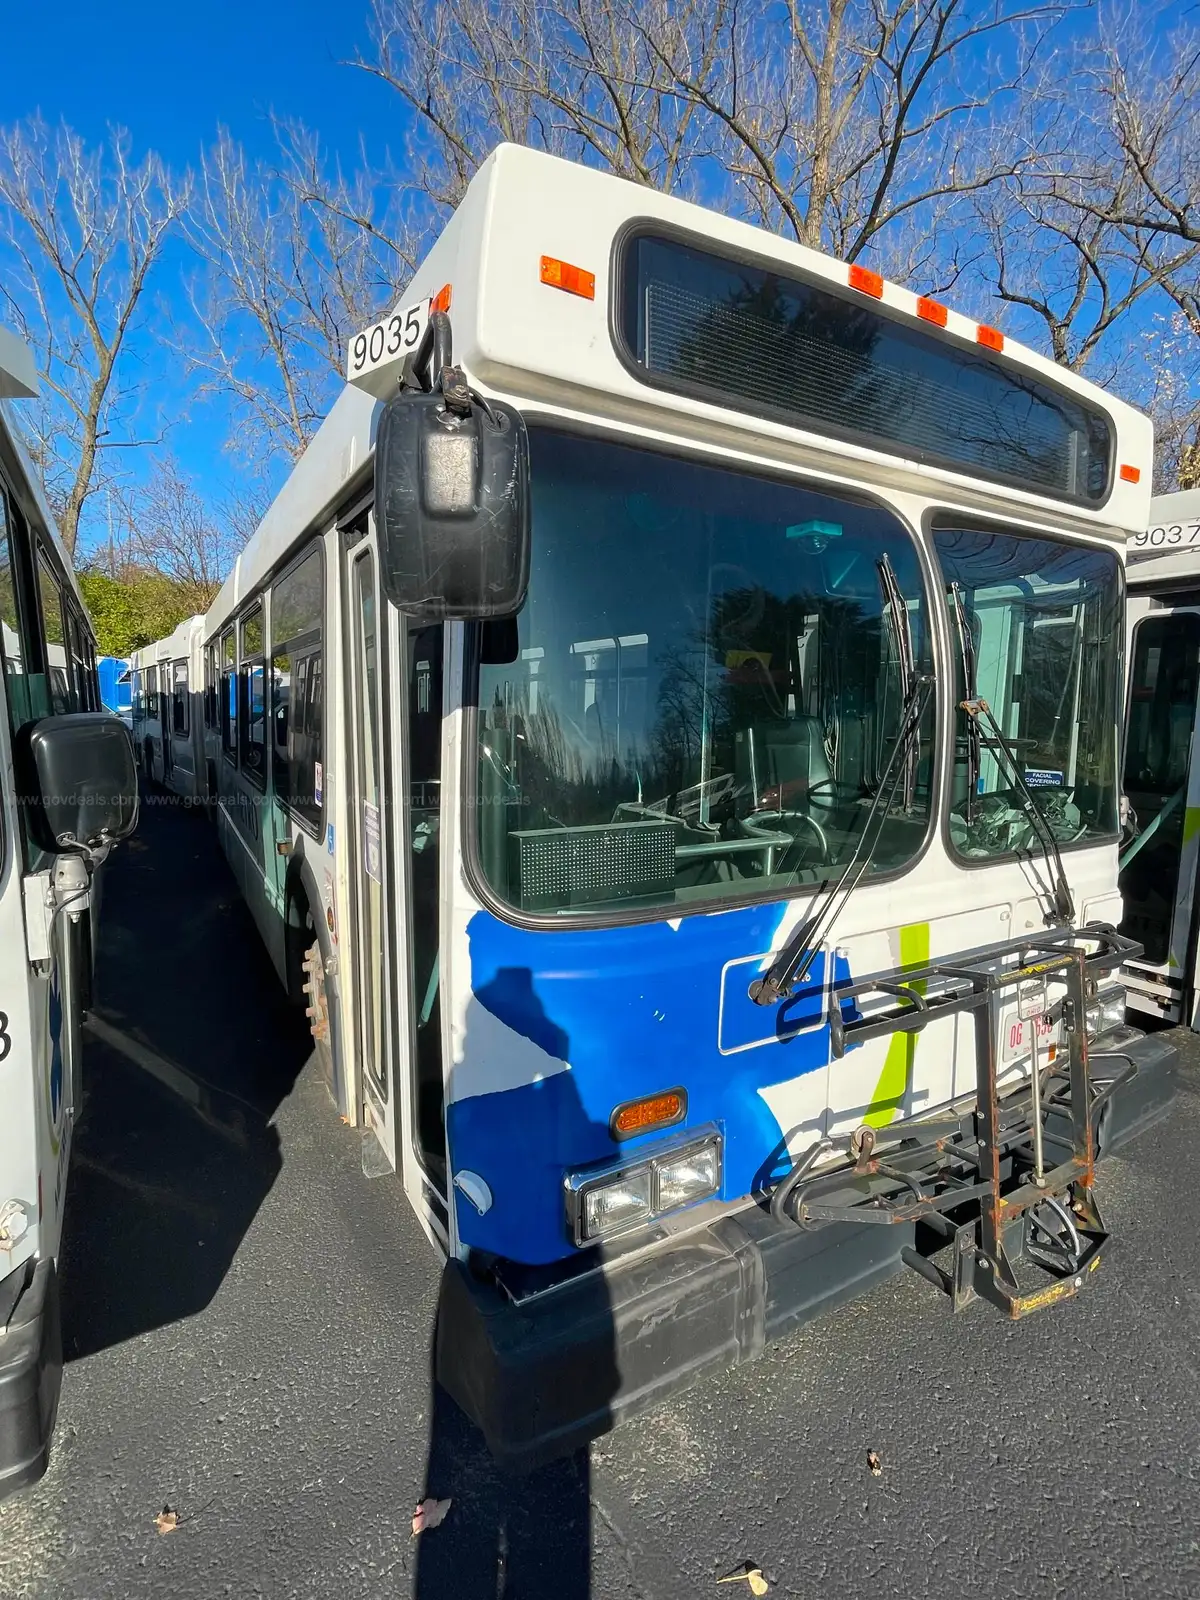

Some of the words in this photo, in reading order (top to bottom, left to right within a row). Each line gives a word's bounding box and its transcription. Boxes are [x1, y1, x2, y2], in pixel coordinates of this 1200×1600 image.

[354, 305, 420, 371] 9035
[1135, 525, 1200, 546] 9037
[1024, 777, 1061, 785] COVERING
